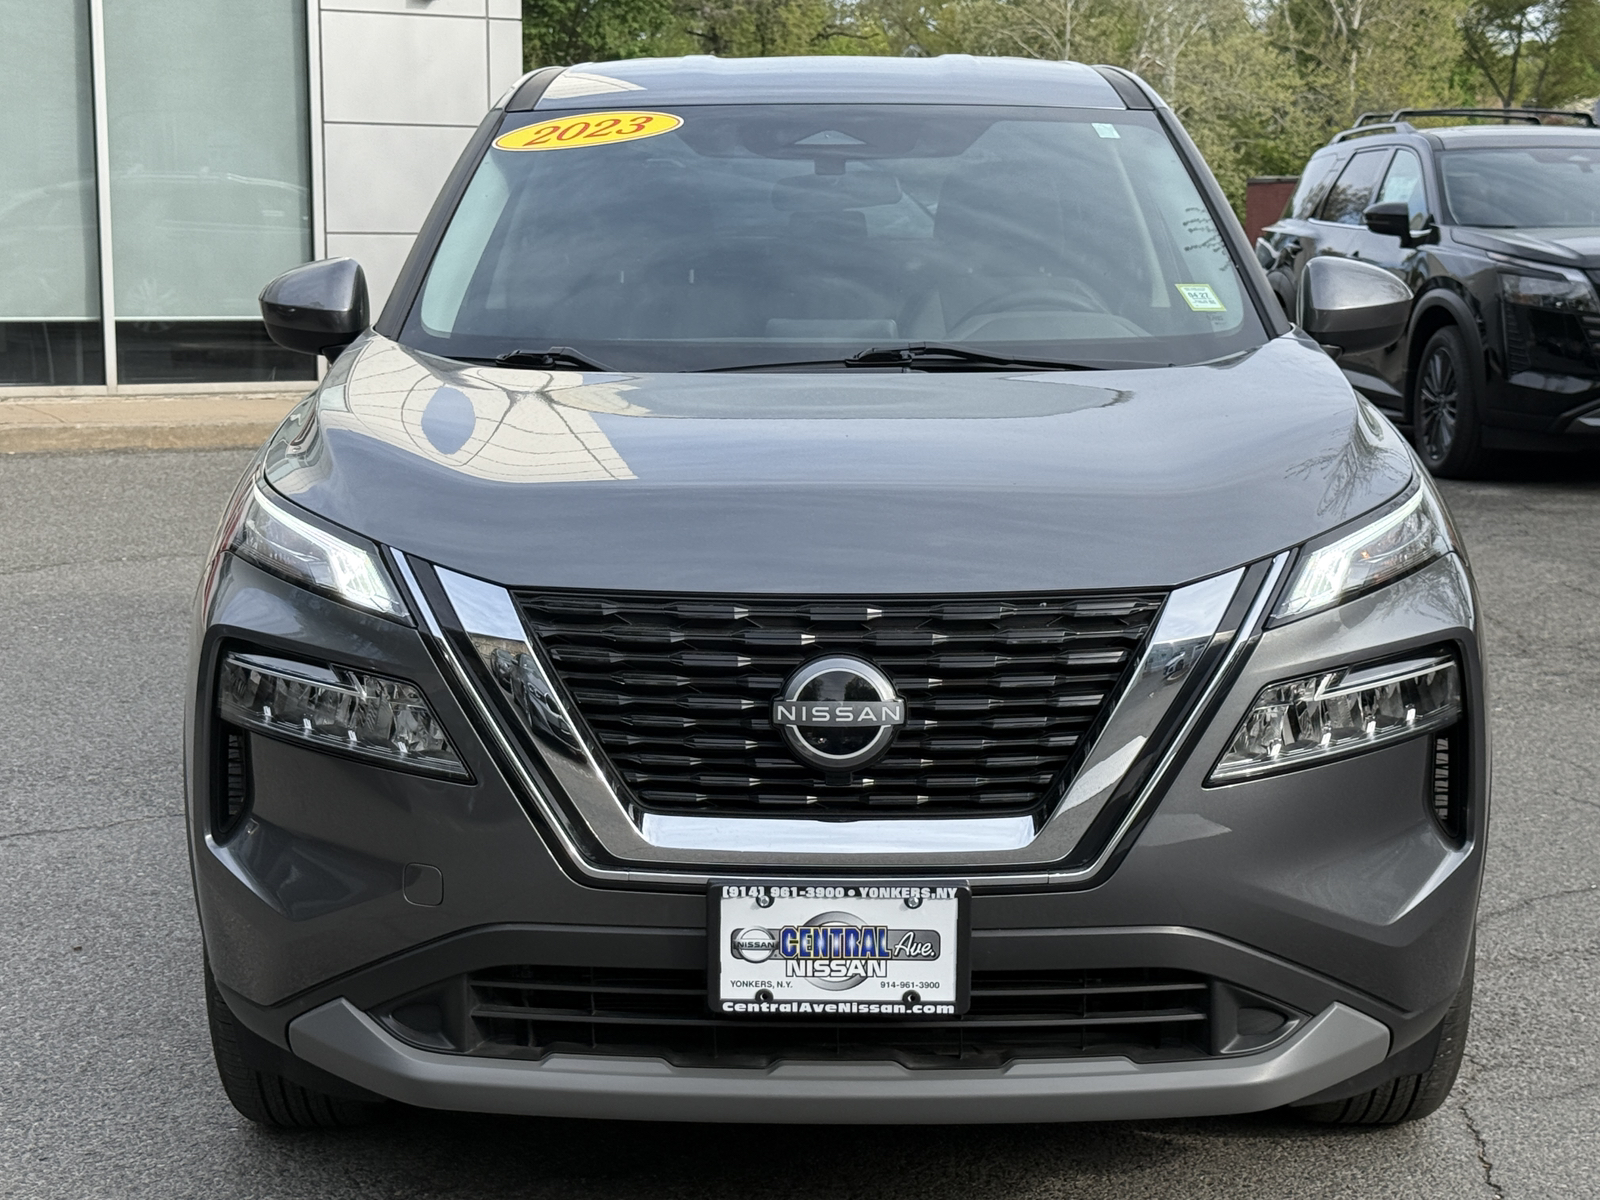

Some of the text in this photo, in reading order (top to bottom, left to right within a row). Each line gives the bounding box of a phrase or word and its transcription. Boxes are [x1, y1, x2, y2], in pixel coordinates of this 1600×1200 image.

[522, 116, 654, 147] 2023
[777, 705, 900, 722] NISSAN
[770, 887, 845, 898] 961-3900
[737, 925, 936, 960] NISSAN CENTRAL Ave.
[786, 960, 887, 978] NISSAN
[730, 980, 793, 989] YONKERS, N.Y.
[880, 981, 940, 989] 914-961-3900
[722, 1001, 955, 1014] CentralAveNissan.com
